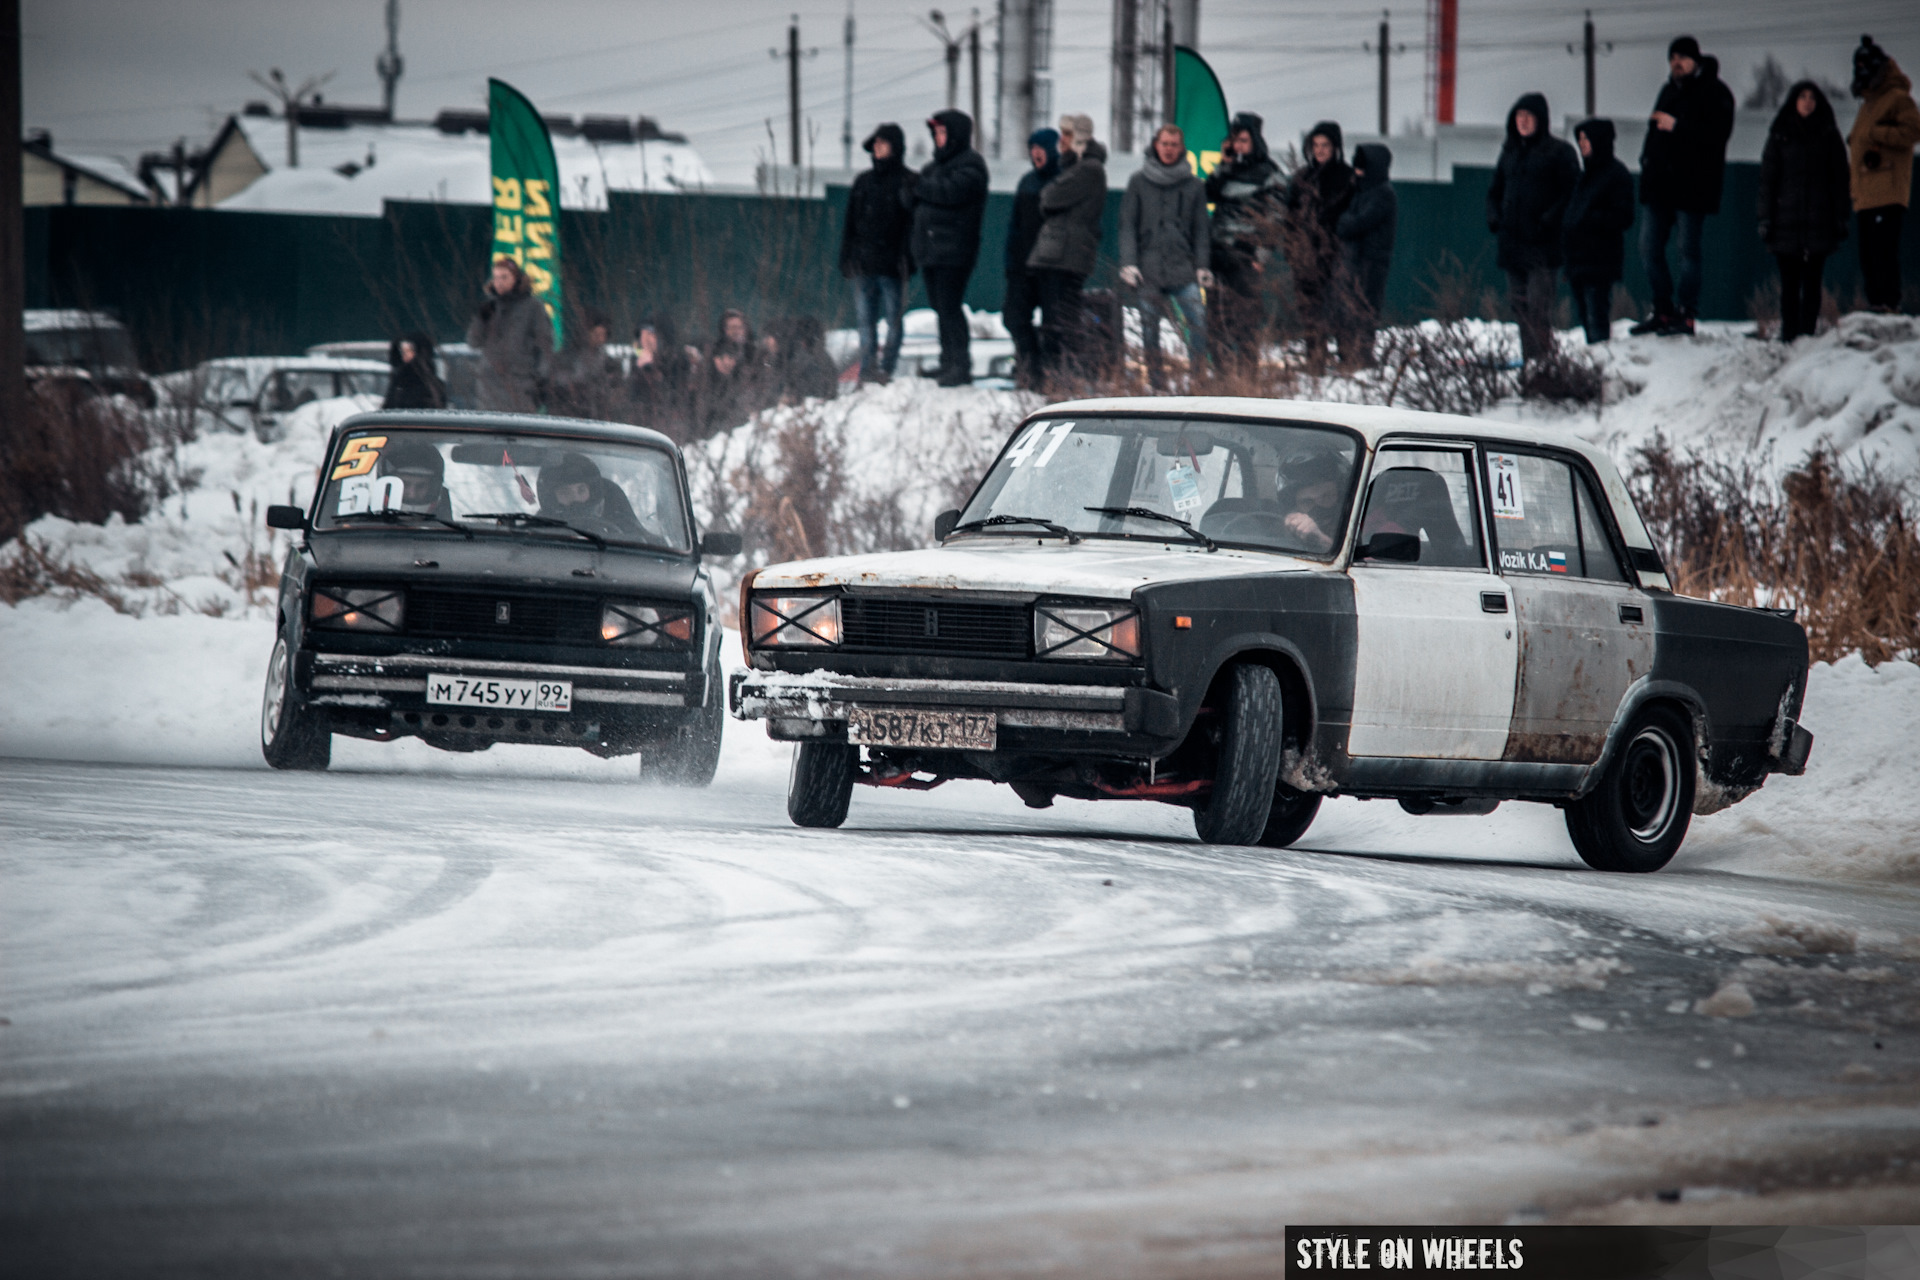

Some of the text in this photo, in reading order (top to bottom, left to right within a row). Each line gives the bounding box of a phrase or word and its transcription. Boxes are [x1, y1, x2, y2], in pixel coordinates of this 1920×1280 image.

[331, 436, 388, 481] 5
[1005, 420, 1076, 468] 41
[337, 474, 404, 516] 50
[1498, 472, 1515, 507] 41
[1499, 550, 1527, 569] Vozik
[537, 700, 555, 709] RUS
[540, 684, 563, 702] 99
[956, 715, 989, 738] 177
